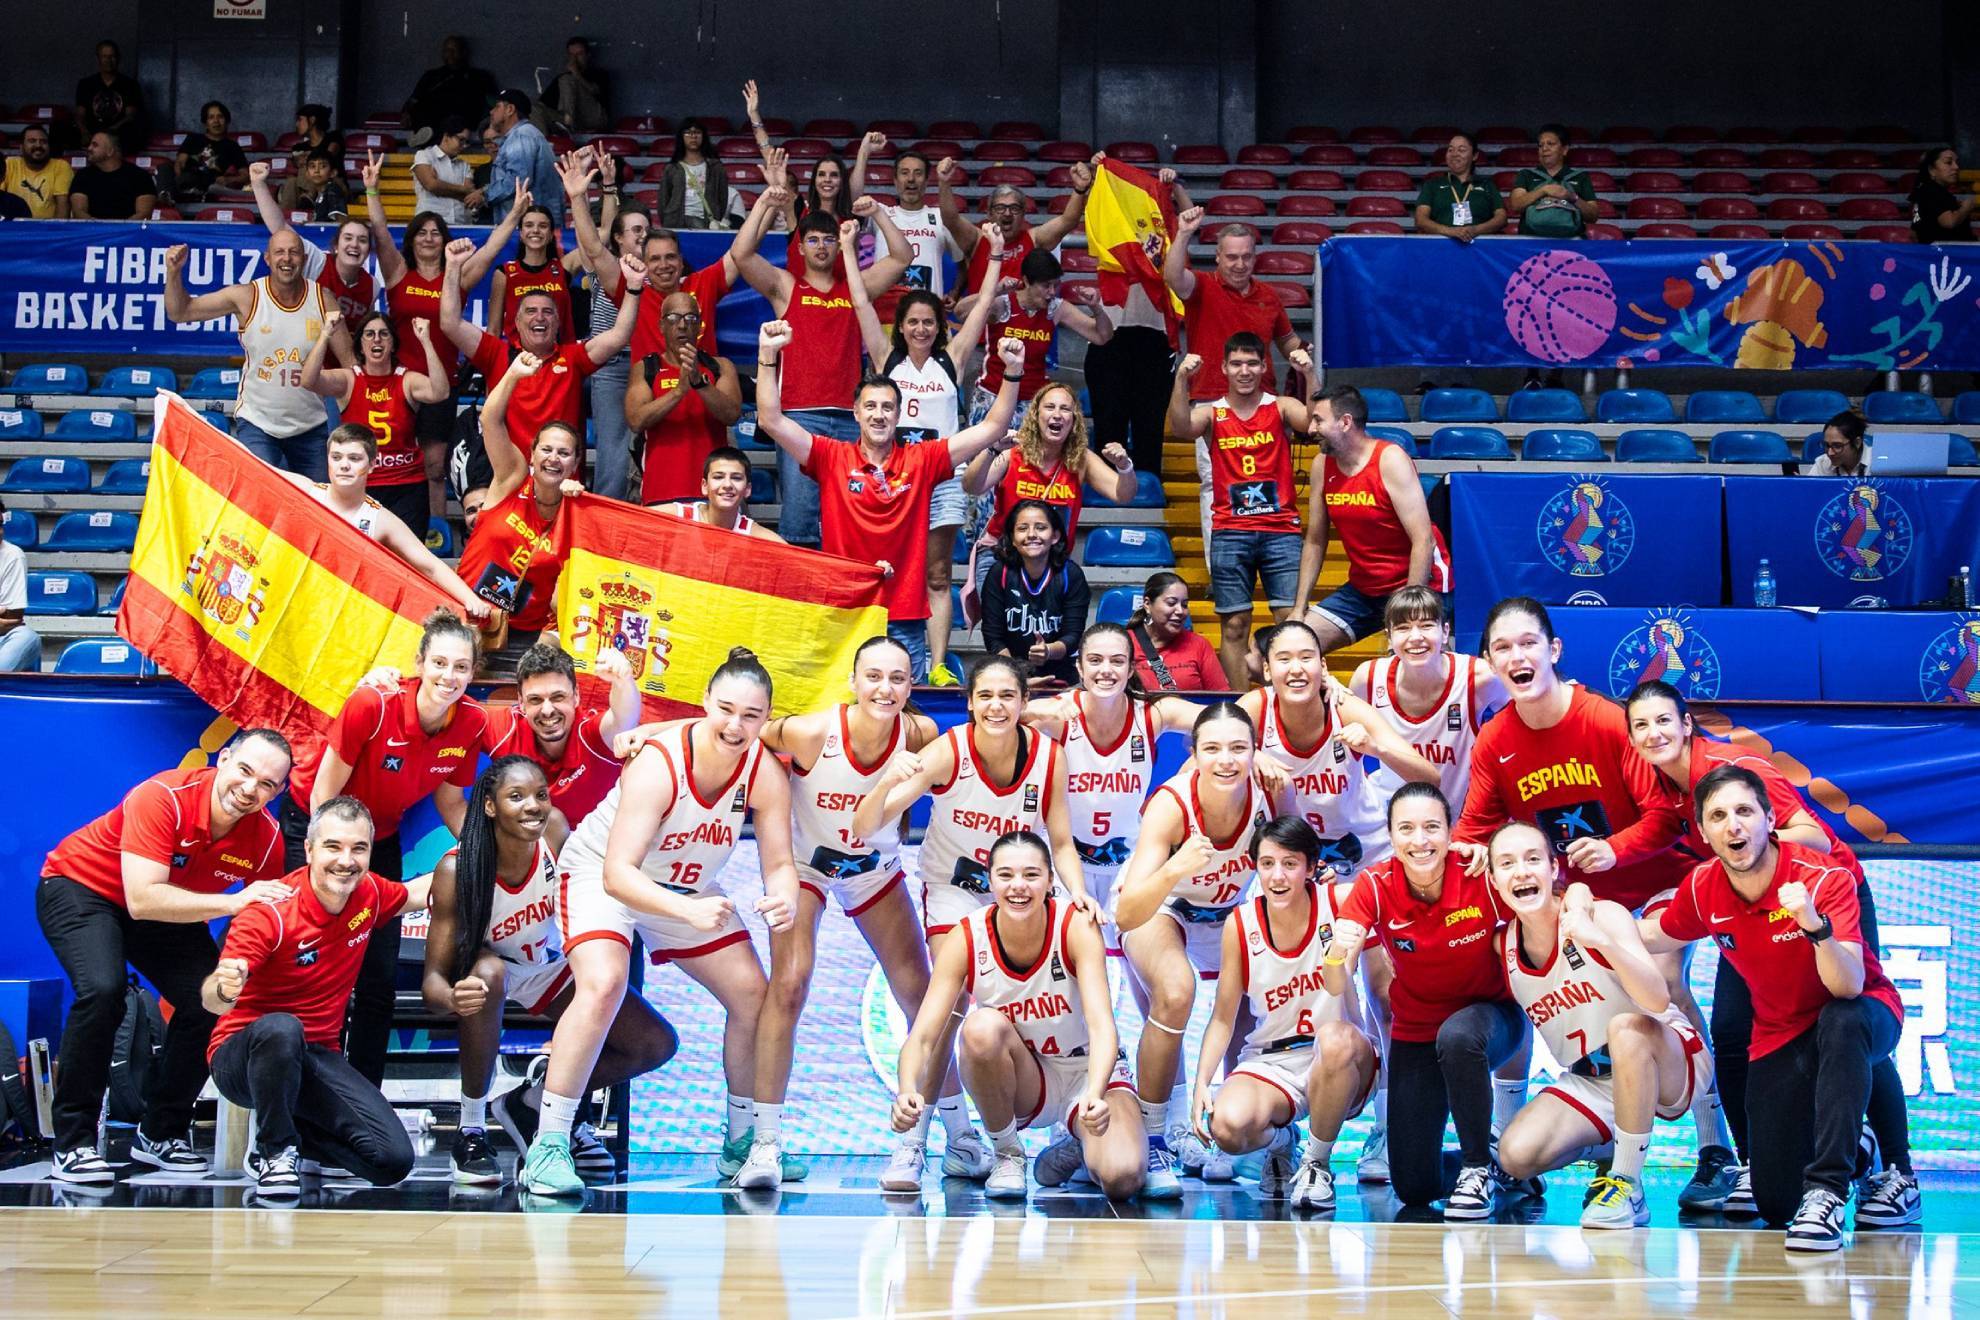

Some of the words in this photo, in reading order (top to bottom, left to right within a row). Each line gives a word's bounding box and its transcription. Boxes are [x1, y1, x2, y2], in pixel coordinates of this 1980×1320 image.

[216, 8, 230, 16] NO
[231, 8, 263, 17] FUMAR
[900, 228, 937, 239] SPAÑA
[188, 248, 261, 286] U17
[405, 286, 442, 299] ESPA
[1005, 326, 1051, 342] ESPAÑA
[257, 347, 304, 382] ESPA
[279, 368, 302, 388] 15
[907, 399, 920, 417] 6
[368, 410, 392, 446] 5
[1218, 431, 1275, 450] ESPAÑA
[374, 451, 414, 467] desa
[1242, 455, 1256, 476] 8
[1325, 490, 1377, 507] ESPAÑA
[1412, 739, 1457, 765] AÑA
[1067, 769, 1142, 794] ESPAÑA
[1293, 768, 1349, 796] PAÑA
[1516, 757, 1602, 802] ESPAÑA
[816, 792, 866, 812] ESP
[1092, 811, 1112, 836] 5
[668, 861, 703, 884] 16
[491, 895, 554, 942] ESPAÑ
[1445, 905, 1483, 927] ESPAÑA
[1768, 907, 1794, 924] ESPA
[1448, 928, 1487, 948] endesa
[1265, 965, 1325, 1012] ESPAÑ
[1526, 979, 1606, 1028] ESPAÑA
[1296, 1008, 1315, 1034] 6
[1566, 1028, 1587, 1058] 7
